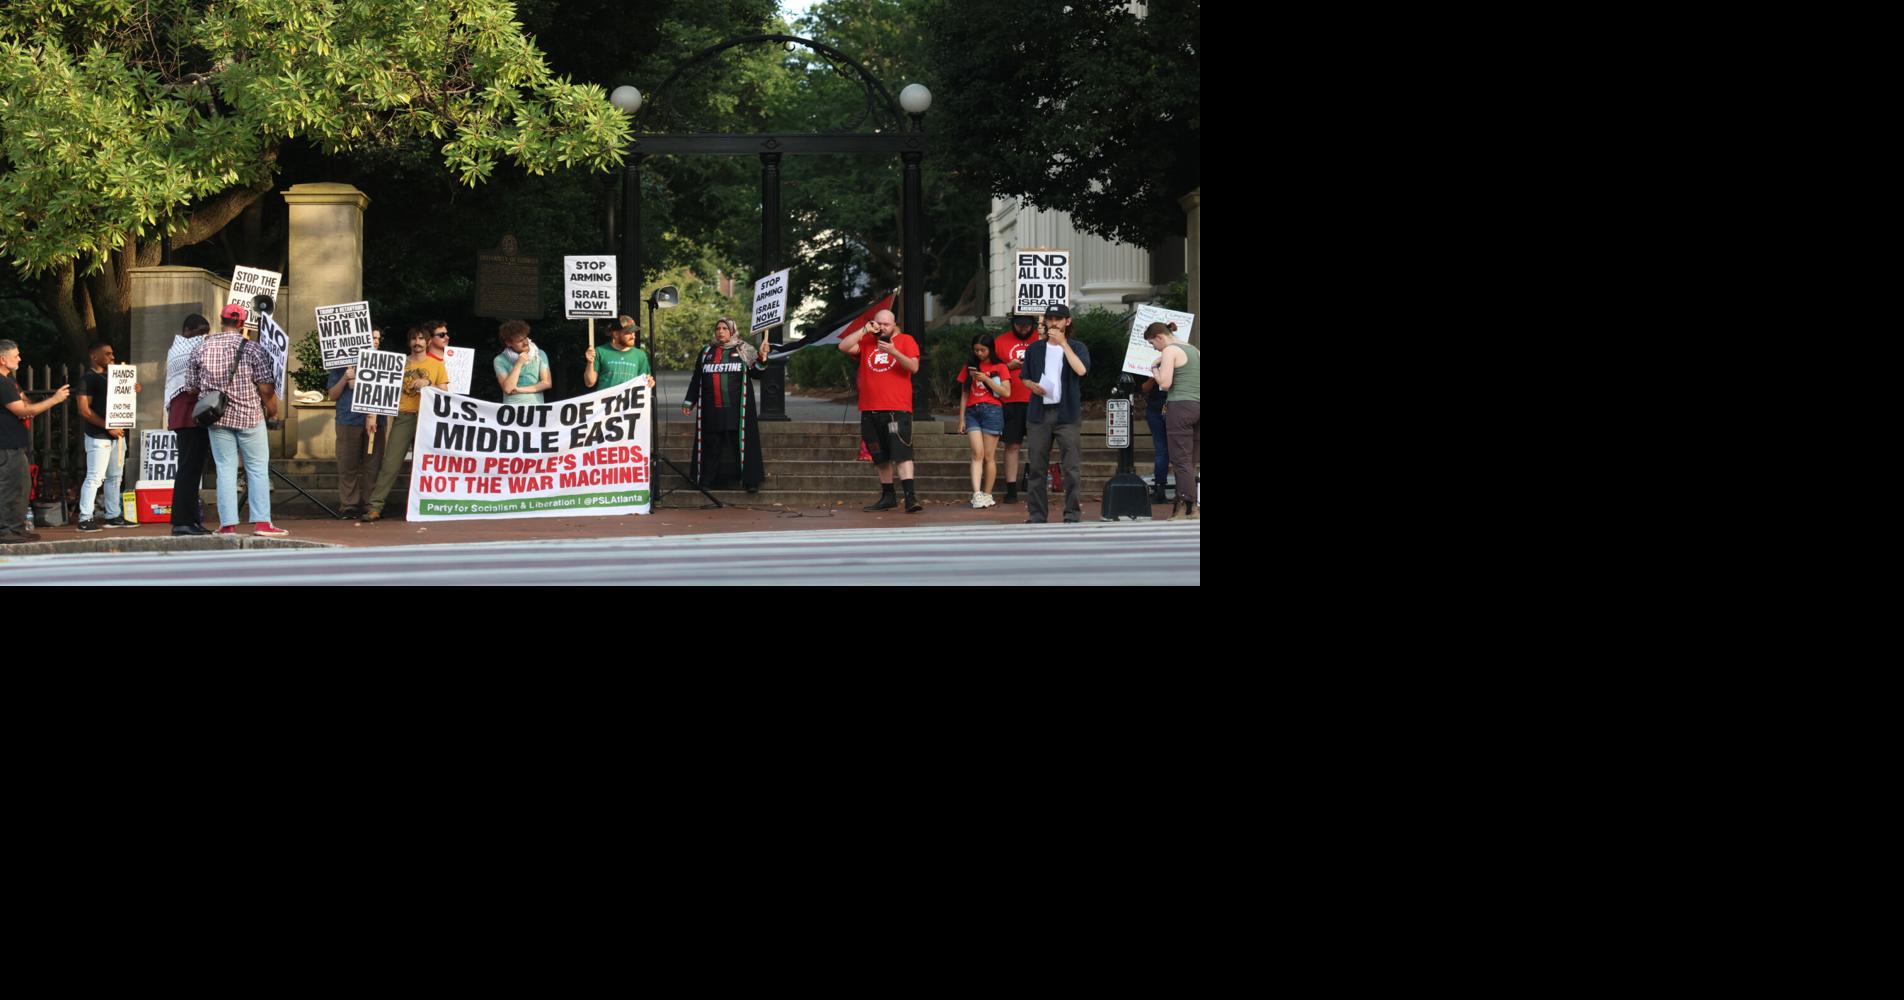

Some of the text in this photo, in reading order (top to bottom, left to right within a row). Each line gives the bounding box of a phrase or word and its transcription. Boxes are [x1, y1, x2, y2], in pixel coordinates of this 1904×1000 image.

[576, 261, 606, 270] STOP
[1018, 254, 1066, 266] END
[236, 271, 277, 288] STOP THE
[570, 273, 612, 282] ARMING
[1018, 267, 1066, 280] ALL U.S.
[233, 282, 276, 299] GENOCIDE
[760, 277, 780, 290] STOP
[1018, 284, 1066, 298] AID TO
[572, 290, 610, 299] ISRAEL
[756, 286, 783, 302] ARMING
[574, 300, 607, 310] NOW!
[756, 300, 780, 315] ISRAEL
[318, 310, 367, 322] NO NEW
[756, 310, 778, 323] NOW!
[262, 314, 286, 352] NO
[320, 318, 369, 338] WAR IN
[322, 335, 371, 350] THE MIDDLE
[360, 352, 403, 372] HANDS
[702, 362, 742, 372] PALESTINE
[112, 370, 134, 378] HANDS
[358, 368, 402, 384] OFF
[114, 386, 131, 394] IRAN!
[354, 382, 400, 408] IRAN!
[433, 386, 645, 427] U.S. OUT OF THE
[434, 413, 641, 453] MIDDLE EAST
[152, 434, 178, 450] HAN
[151, 450, 178, 461] OF
[422, 445, 648, 474] FUND PEOPLE'S NEEDS,
[148, 463, 178, 480] IRA
[420, 466, 649, 494] NOT THE WAR MACHINE!
[427, 504, 453, 515] Party
[454, 503, 468, 512] for
[471, 503, 518, 512] Socialism
[529, 499, 576, 509] Liberation
[584, 494, 643, 505] @PSLAtlanta
